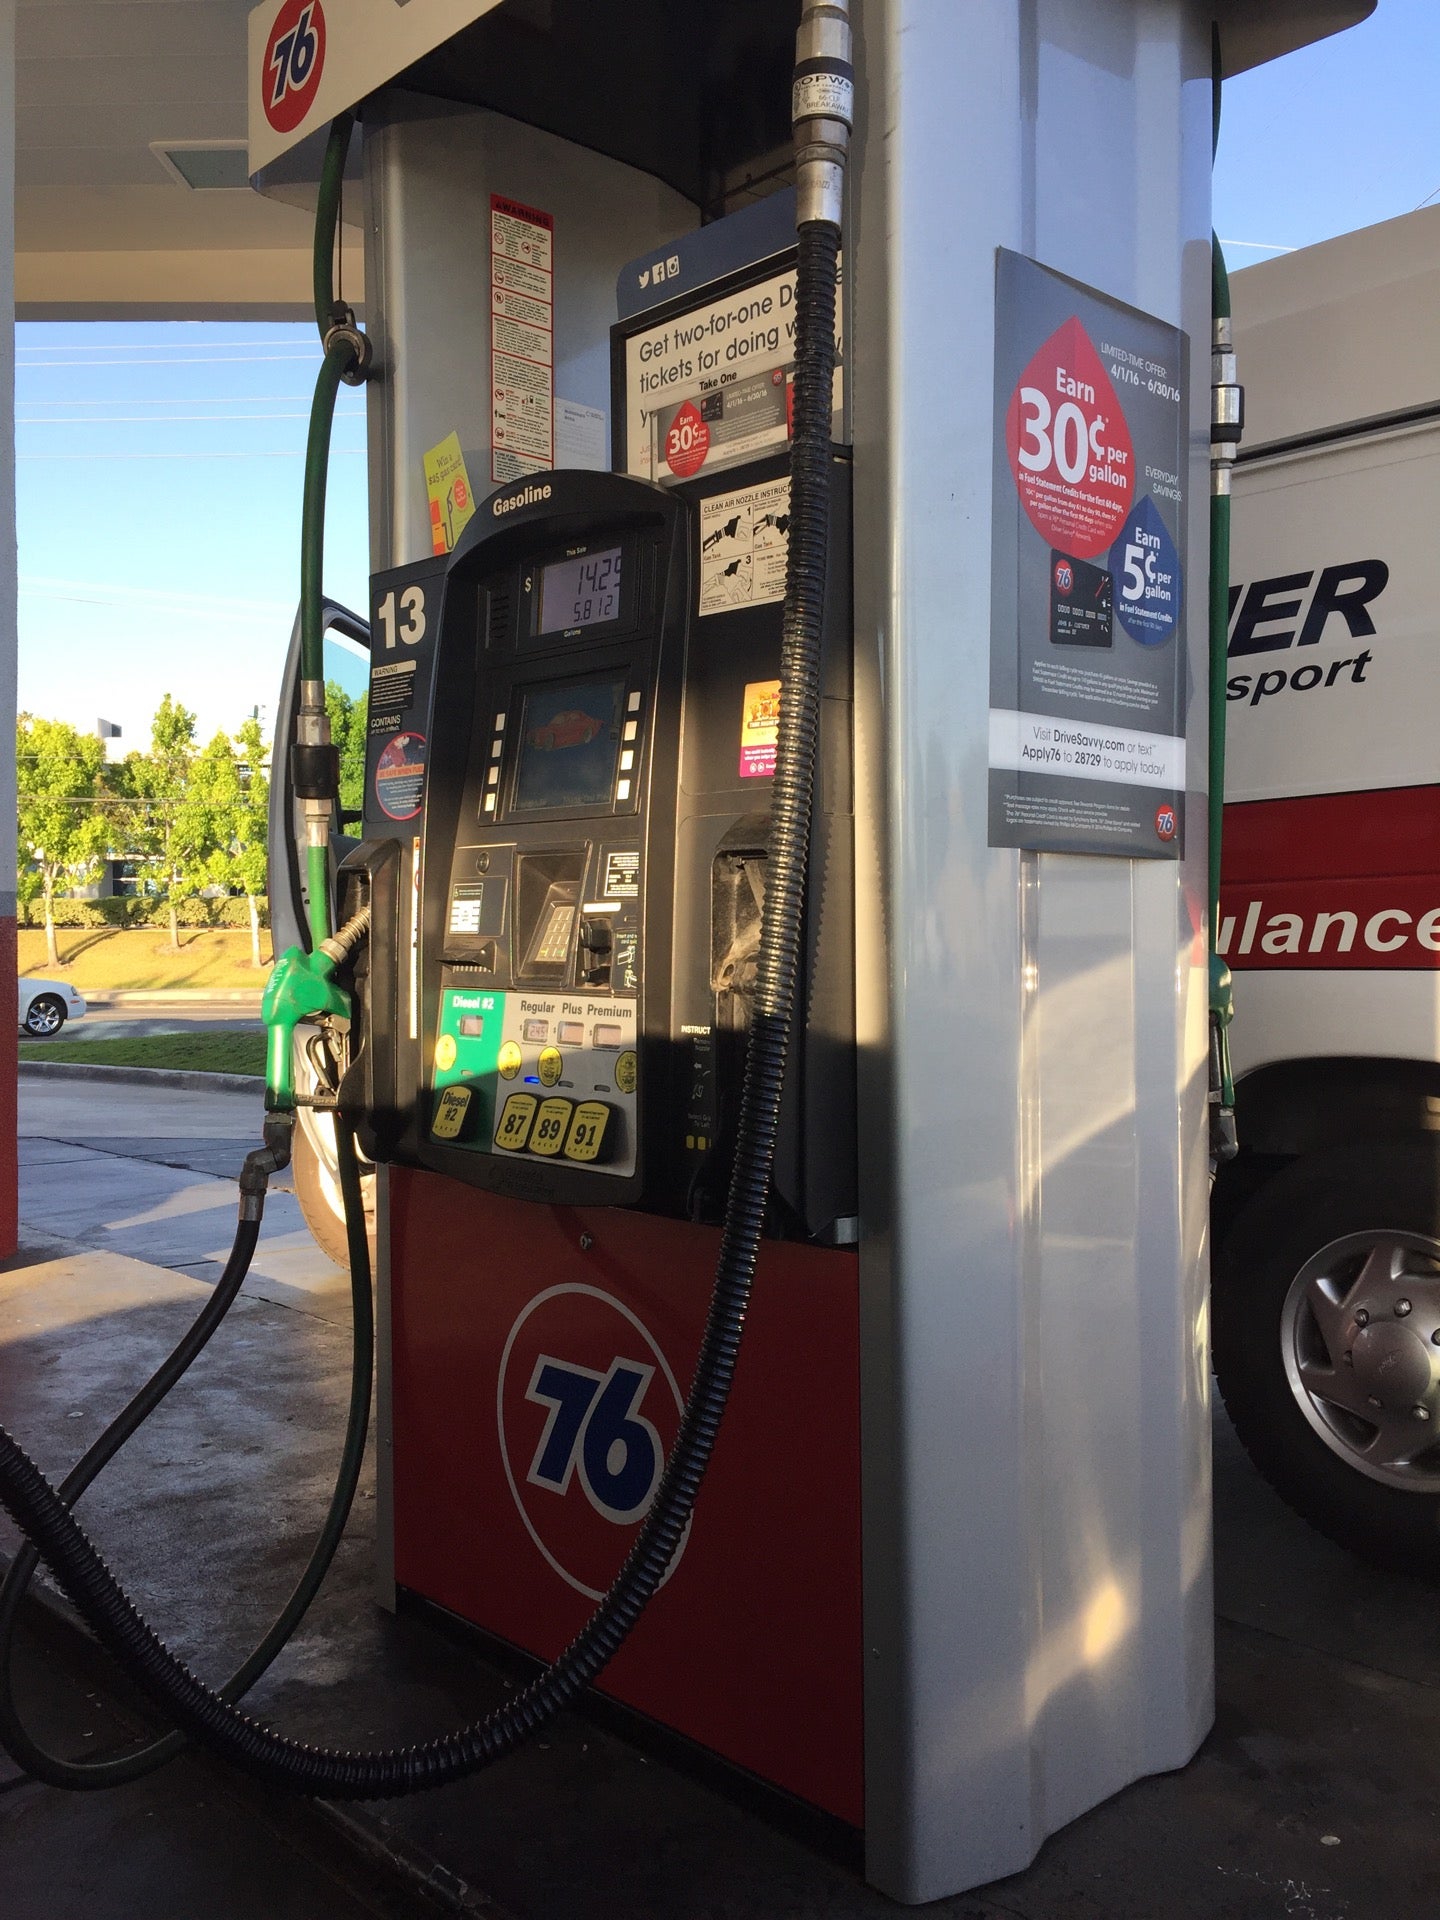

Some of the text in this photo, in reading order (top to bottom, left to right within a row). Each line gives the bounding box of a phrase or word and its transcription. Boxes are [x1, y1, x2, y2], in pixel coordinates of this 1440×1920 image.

[270, 1, 318, 109] 76
[802, 75, 844, 85] OPW
[639, 334, 668, 362] Get
[673, 297, 773, 350] two-for-one
[640, 359, 693, 394] tickets
[698, 349, 720, 373] for
[725, 325, 779, 361] doing
[1101, 342, 1144, 369] LIMITED-TIME
[699, 371, 737, 392] Take One
[1056, 367, 1095, 404] Earn
[1111, 364, 1139, 386] 4/1/16
[1147, 378, 1180, 403] 6/30/16
[680, 416, 693, 425] Earn
[1107, 448, 1128, 464] per
[1089, 465, 1127, 489] gallon
[1145, 465, 1179, 484] EVERYDAY
[492, 484, 552, 516] Gasoline
[704, 503, 724, 513] CLEAN
[725, 500, 735, 509] AIR
[735, 492, 759, 505] NOZZLE
[747, 506, 751, 516] 1
[1135, 526, 1161, 550] Earn
[745, 555, 752, 565] 3
[524, 577, 532, 593] $
[1057, 568, 1071, 589] 76
[1157, 572, 1172, 585] per
[1145, 584, 1172, 601] gallon
[378, 586, 426, 649] 13
[373, 665, 398, 676] WARNING
[370, 714, 401, 728] CONTAINS
[1033, 726, 1051, 742] Visit
[1053, 730, 1125, 752] DriveSavvy.com
[1127, 743, 1136, 752] or
[1022, 745, 1166, 778] Apply76 to 28729 to apply today!
[1157, 812, 1173, 833] 76
[452, 995, 495, 1010] Diesel #2
[520, 1000, 632, 1018] Regular Plus Premium
[442, 1091, 470, 1108] Diesel
[444, 1108, 458, 1122] #2
[504, 1113, 527, 1136] 87
[538, 1118, 562, 1141] 89
[574, 1123, 597, 1147] 91
[525, 1354, 664, 1525] 76
